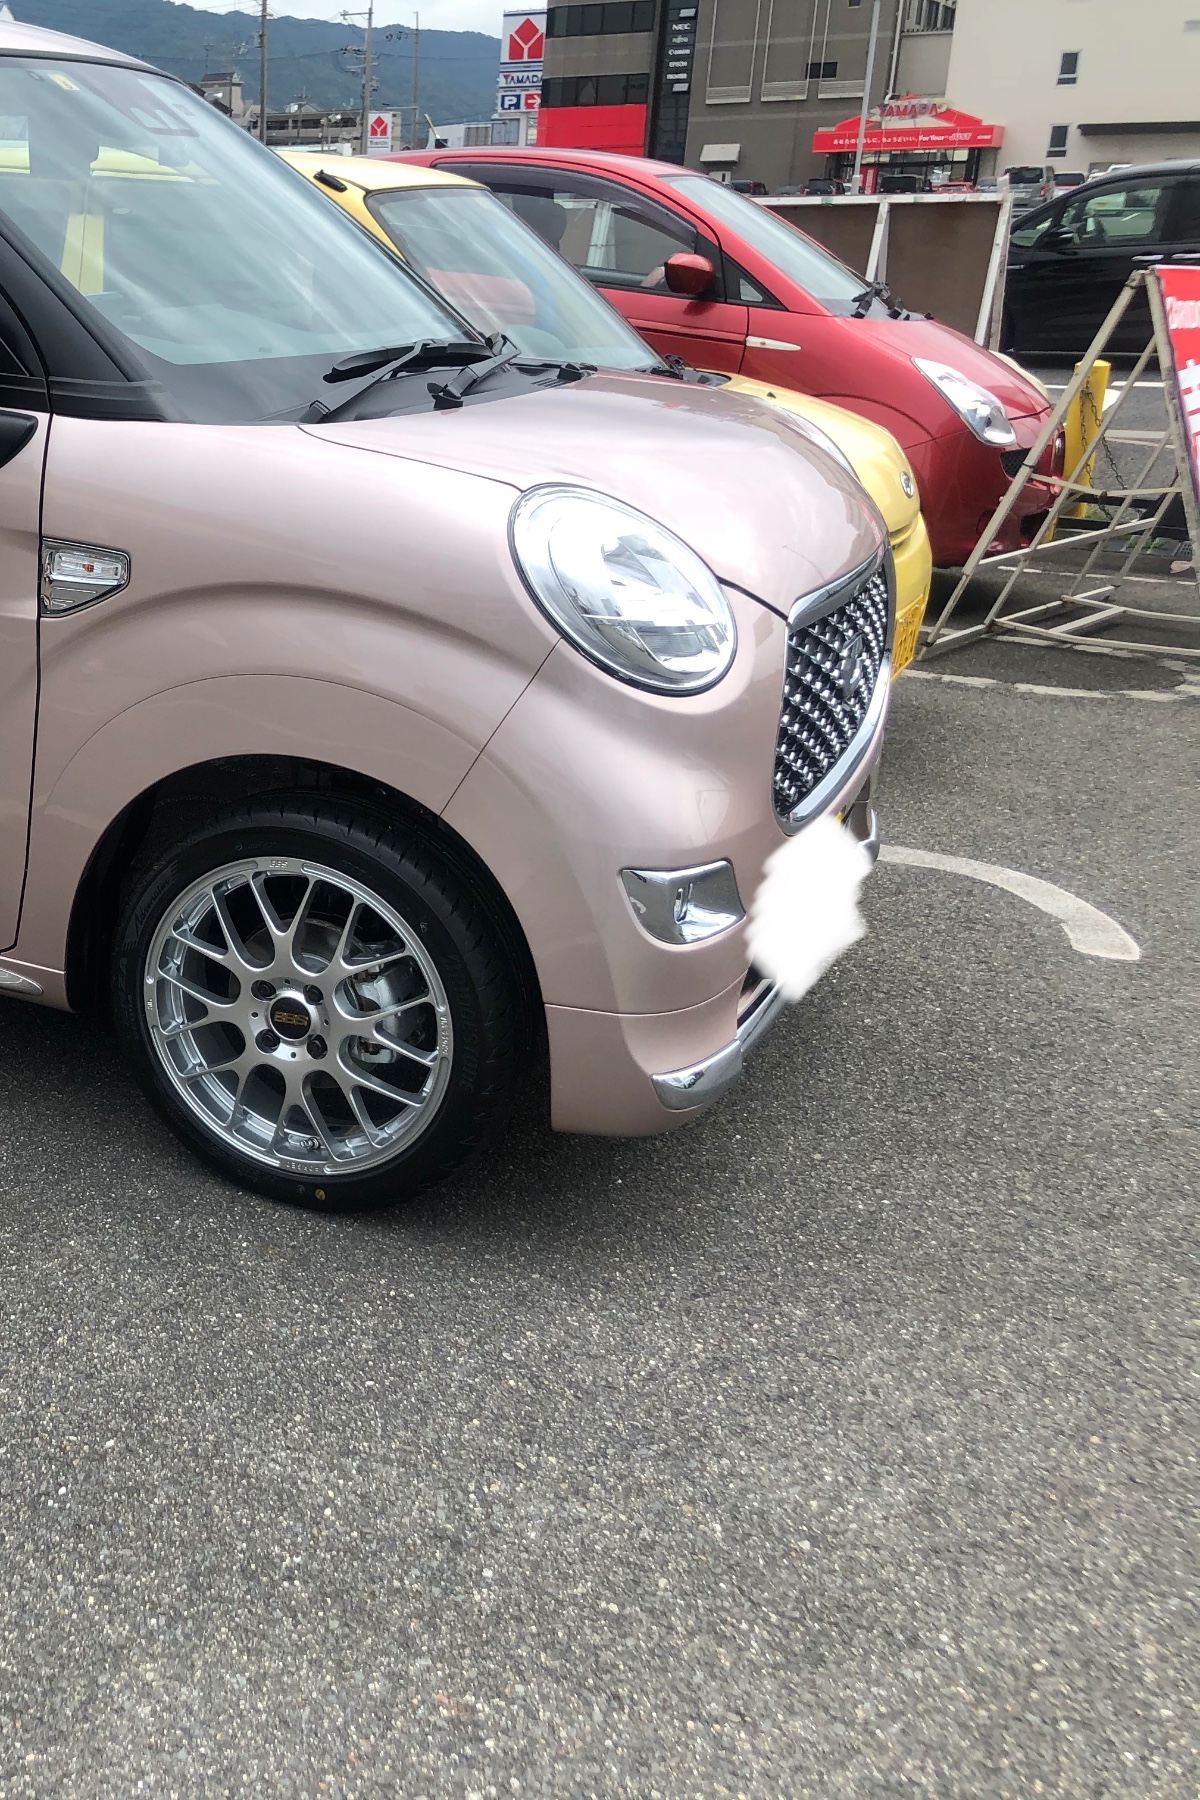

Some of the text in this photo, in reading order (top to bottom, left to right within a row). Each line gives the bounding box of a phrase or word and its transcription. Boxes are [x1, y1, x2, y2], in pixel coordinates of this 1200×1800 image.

[672, 23, 691, 31] NEC
[503, 96, 518, 110] P
[877, 103, 939, 117] YAMADA
